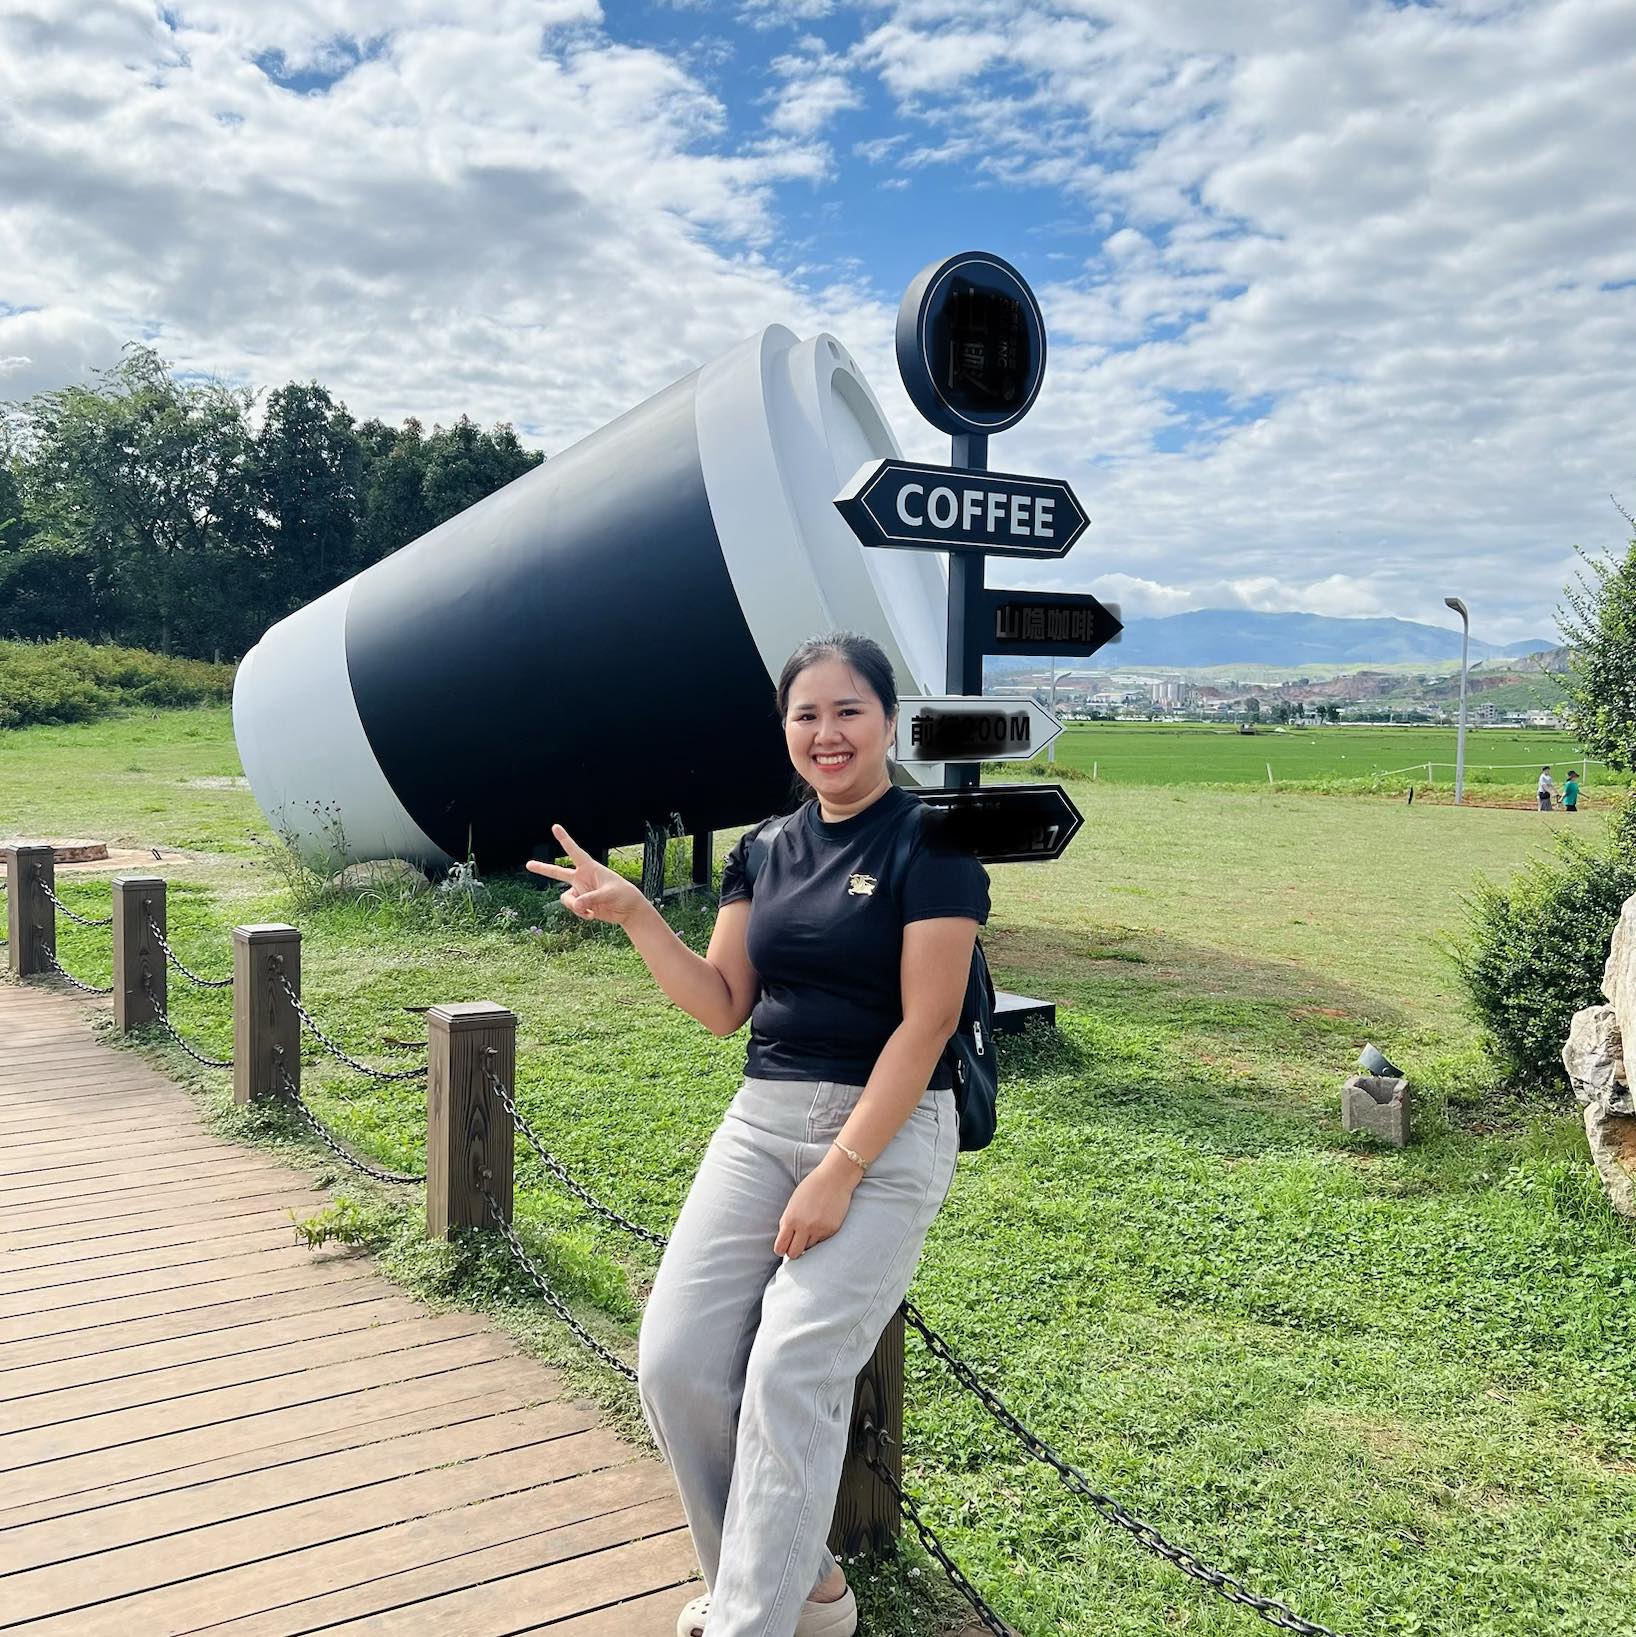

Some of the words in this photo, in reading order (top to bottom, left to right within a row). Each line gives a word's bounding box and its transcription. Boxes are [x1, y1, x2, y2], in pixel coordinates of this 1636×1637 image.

[896, 483, 1055, 537] COFFEE
[996, 606, 1095, 641] 山隐咖啡
